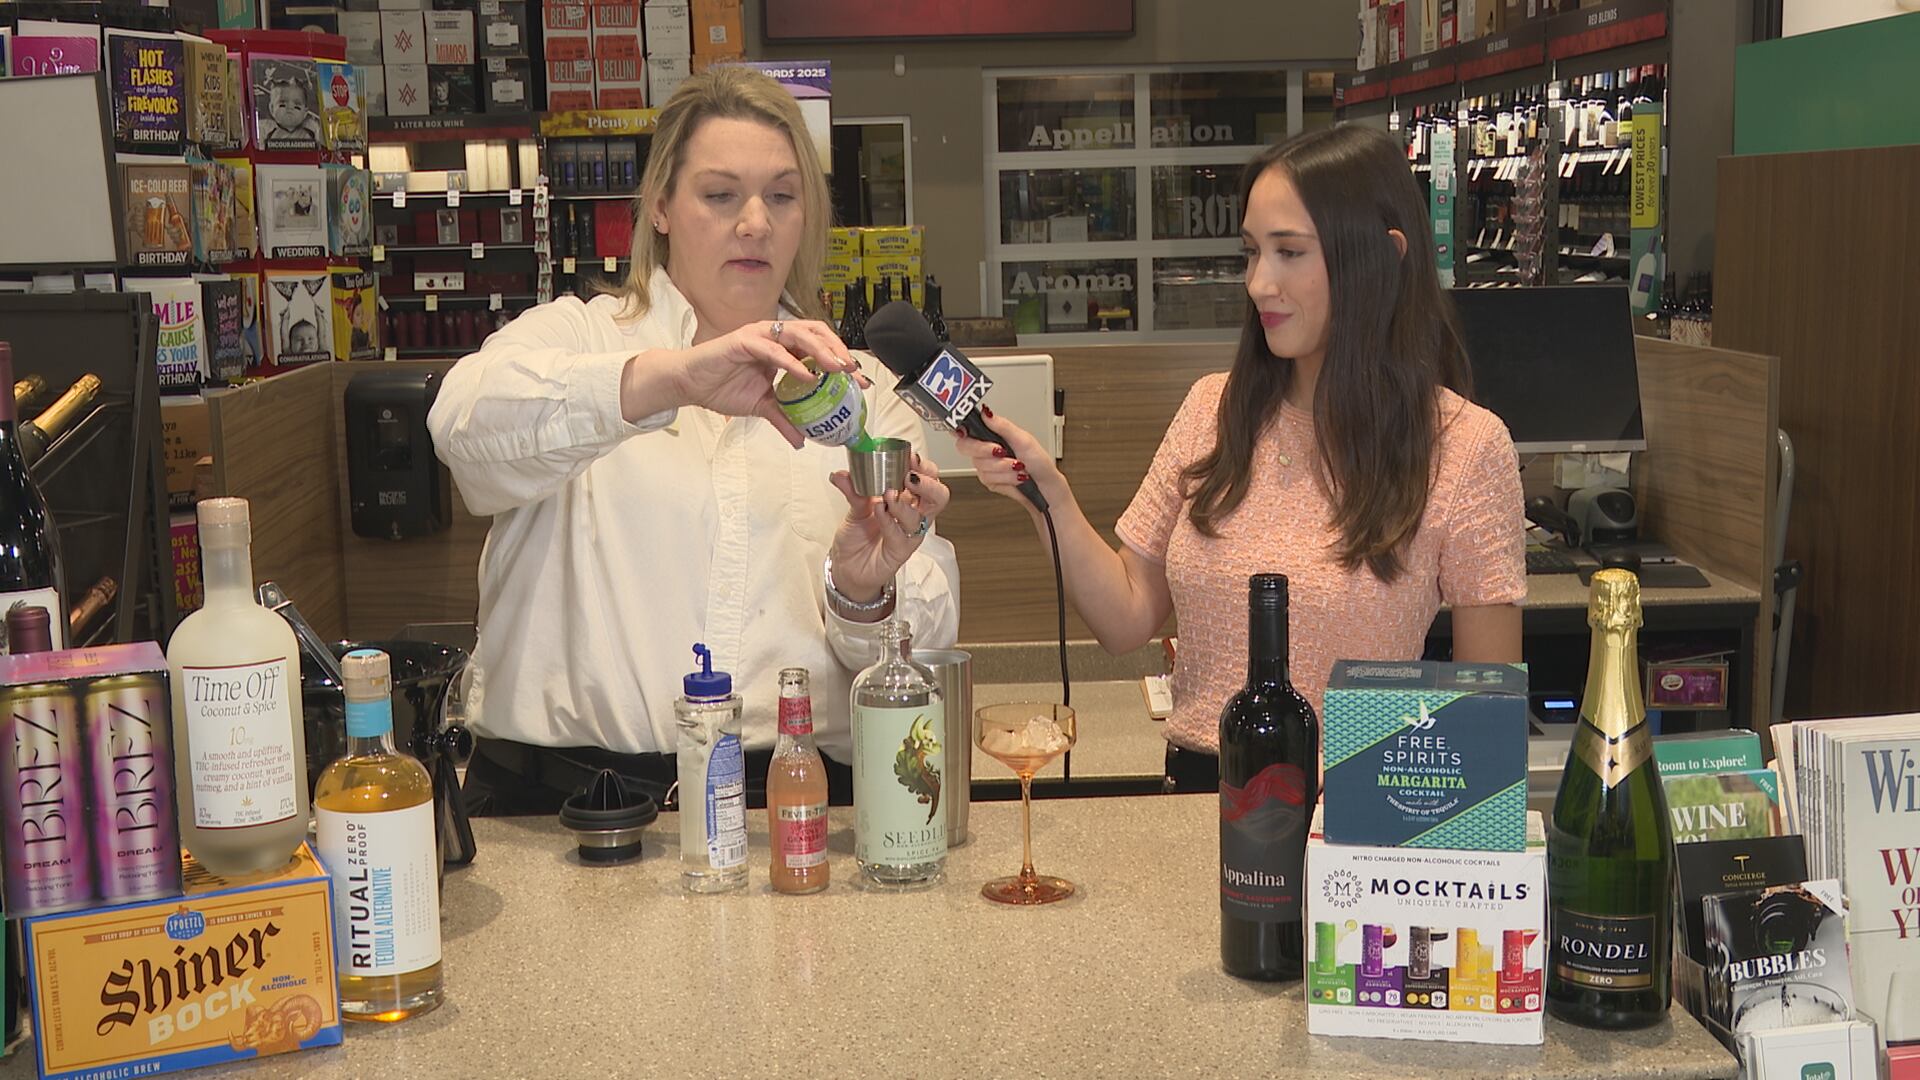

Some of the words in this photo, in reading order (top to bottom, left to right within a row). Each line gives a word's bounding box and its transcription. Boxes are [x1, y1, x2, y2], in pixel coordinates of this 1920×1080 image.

[601, 6, 633, 26] BELLINI
[1588, 13, 1598, 26] RED
[1599, 8, 1617, 24] BLENDS
[138, 49, 164, 68] HOT
[436, 44, 468, 63] MIMOSA
[130, 68, 174, 87] FLASHES
[603, 60, 636, 79] BELLINI
[762, 69, 794, 78] ARDS
[797, 68, 826, 78] 2025
[203, 74, 221, 90] KIDS
[332, 84, 348, 97] STOP
[394, 121, 399, 129] 3
[401, 121, 423, 129] LITER
[425, 120, 442, 128] BOX
[444, 120, 464, 128] WINE
[588, 116, 630, 130] Plenty
[635, 117, 647, 127] to
[133, 129, 180, 141] BIRTHDAY
[1028, 122, 1234, 150] Appellation
[1636, 128, 1645, 168] PRICES
[1647, 161, 1655, 173] 30
[130, 179, 168, 193] ICE-COLD
[168, 179, 188, 193] BEER
[1635, 172, 1644, 216] LOWEST
[138, 252, 188, 264] BIRTHDAY
[277, 247, 320, 257] WEDDING
[1009, 271, 1134, 295] Aroma
[153, 301, 194, 325] MILE
[159, 325, 195, 348] CAUSE
[170, 345, 197, 361] YOUR
[157, 361, 198, 374] RTHDAY
[158, 372, 197, 385] RTHDAY
[946, 375, 993, 429] KBTX
[805, 405, 851, 438] BURST
[191, 675, 242, 701] Time
[246, 665, 280, 701] Off
[201, 705, 242, 718] Coconut
[243, 702, 251, 715] &
[252, 701, 277, 715] Spice
[1398, 736, 1446, 749] FREE
[208, 751, 236, 760] smooth
[237, 749, 252, 759] and
[253, 744, 283, 758] uplifting
[1383, 750, 1461, 765] SPIRITS
[211, 761, 240, 771] infused
[241, 757, 276, 770] refresher
[277, 752, 291, 762] with
[1689, 759, 1700, 770] to
[1702, 754, 1747, 770] Explore!
[203, 774, 229, 783] creamy
[265, 765, 285, 775] warm
[1383, 766, 1461, 775] NON-ALCOHOLIC
[224, 782, 238, 792] and
[246, 779, 262, 790] hint
[272, 772, 293, 785] vanilla
[1377, 774, 1467, 789] MARGARITA
[1760, 778, 1774, 794] FREE
[1861, 749, 1920, 814] Wi
[1399, 789, 1445, 797] COCKTAIL
[1386, 795, 1400, 808] THE
[1398, 804, 1419, 815] SPIRIT
[1671, 802, 1746, 833] WINE
[117, 846, 163, 858] DREAM
[346, 822, 357, 865] ZERO
[358, 824, 368, 866] PROOF
[24, 858, 71, 869] DREAM
[1722, 872, 1766, 881] CONCIERGE
[371, 866, 394, 926] ALTERNATIVE
[1397, 898, 1452, 907] UNIQUELY
[1456, 901, 1504, 910] CRAFTED
[1820, 890, 1834, 903] FREE
[169, 916, 203, 931] SPOETZL
[348, 868, 372, 968] RITUAL
[374, 928, 395, 968] TEQUILA
[1560, 935, 1648, 960] RONDEL
[1729, 948, 1826, 983] BUBBLES
[97, 921, 281, 1037] Shiner
[261, 978, 307, 992] ALCOHOLIC
[1589, 975, 1613, 985] ZERO
[147, 977, 257, 1046] BOCK
[134, 1062, 161, 1075] BREW
